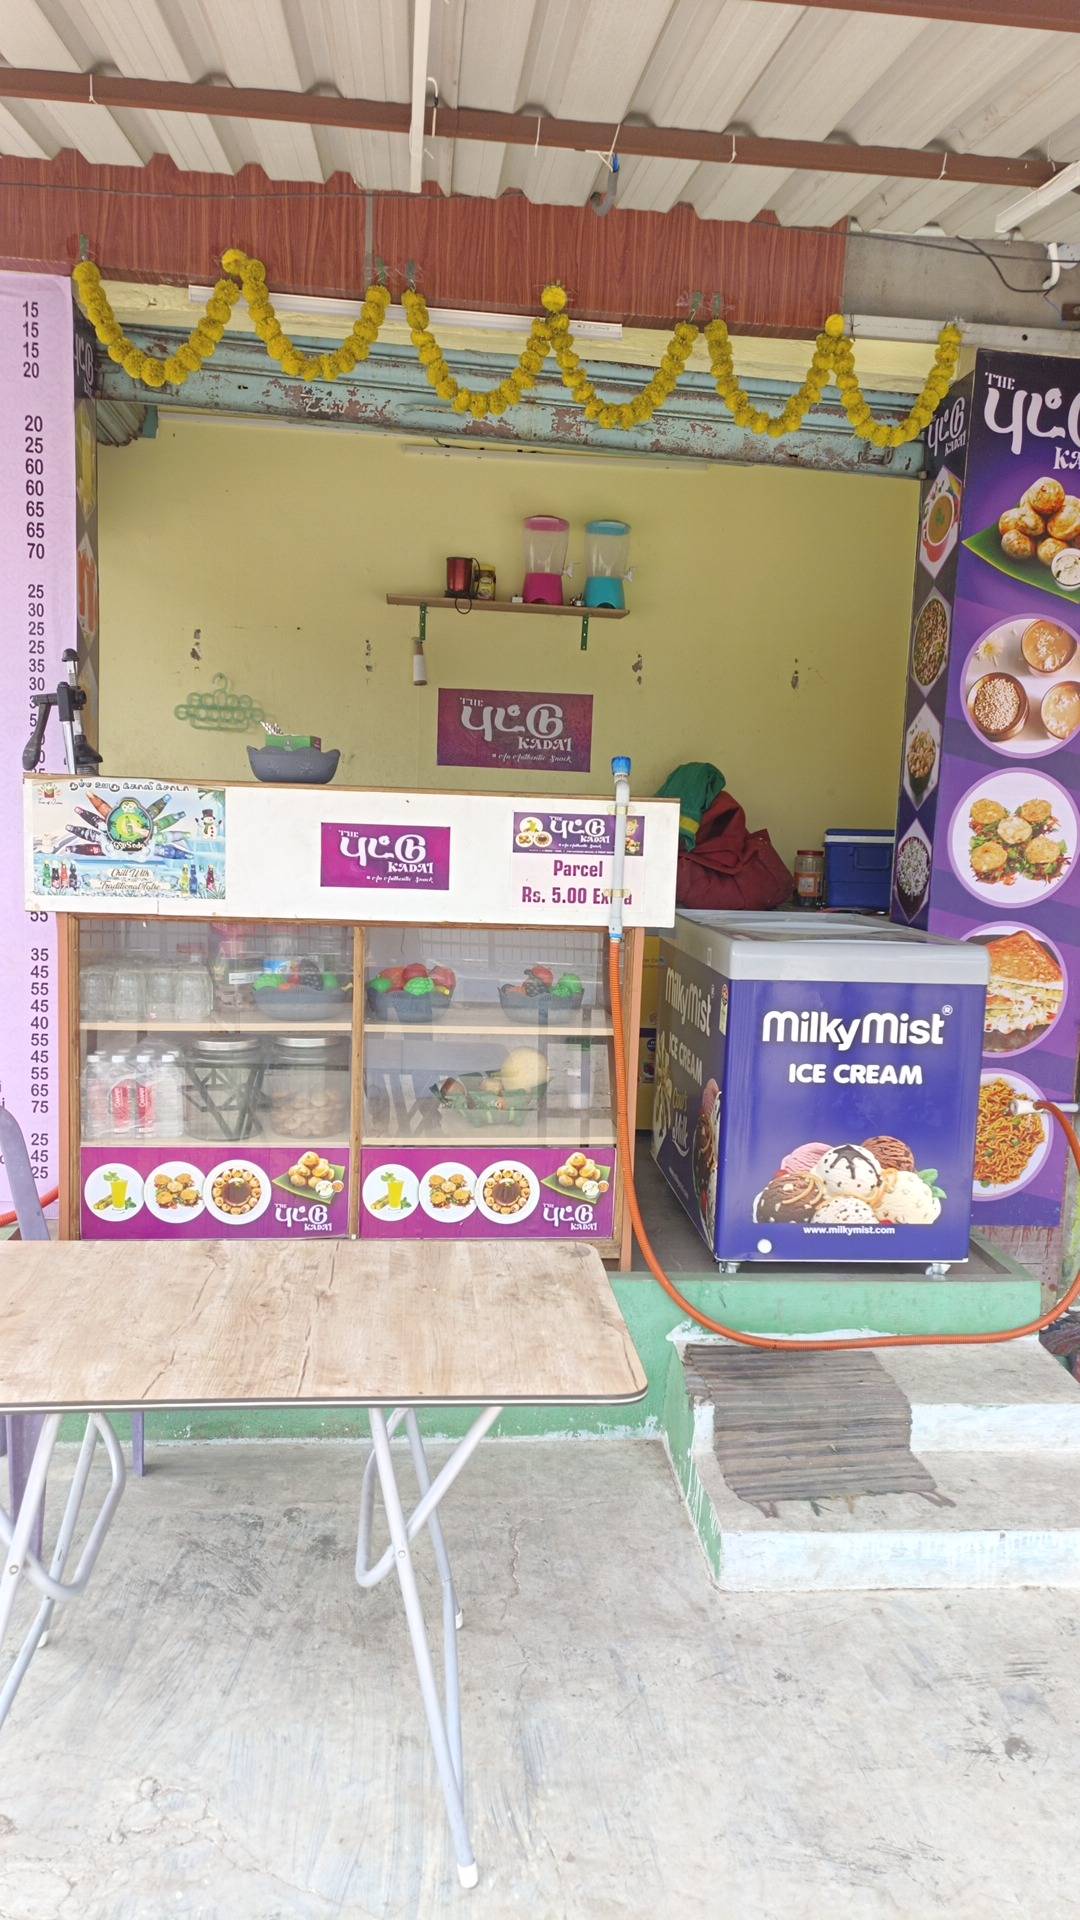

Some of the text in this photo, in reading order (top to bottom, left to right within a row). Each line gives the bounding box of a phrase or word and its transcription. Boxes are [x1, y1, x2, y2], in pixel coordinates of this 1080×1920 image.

[23, 300, 39, 318] 15
[23, 320, 39, 338] 15
[23, 341, 39, 359] 15
[23, 361, 40, 379] 20
[984, 371, 1016, 391] THE
[24, 414, 43, 432] 20
[25, 436, 44, 454] 25
[25, 458, 44, 475] 60
[26, 479, 44, 497] 60
[26, 501, 45, 518] 65
[27, 522, 45, 539] 65
[27, 542, 45, 560] 70
[28, 584, 44, 599] 25
[28, 603, 45, 618] 30
[28, 621, 45, 636] 25
[29, 640, 45, 655] 25
[29, 658, 45, 673] 35
[29, 676, 45, 691] 30
[459, 696, 484, 707] THE
[518, 737, 574, 752] KADAI
[340, 834, 427, 867] புட்டு
[388, 861, 434, 875] KADAI
[553, 859, 603, 878] Parcel
[521, 886, 546, 904] Rs.
[552, 887, 587, 904] 5.00
[31, 948, 49, 961] 35
[30, 965, 49, 978] 45
[31, 982, 49, 995] 55
[30, 999, 49, 1012] 45
[30, 1016, 49, 1029] 40
[31, 1033, 49, 1046] 55
[30, 1050, 49, 1063] 45
[31, 1067, 49, 1080] 55
[788, 1063, 923, 1085] ICE CREAM
[31, 1083, 49, 1097] 65
[31, 1100, 49, 1113] 75
[31, 1133, 49, 1146] 25
[30, 1149, 49, 1162] 45
[31, 1166, 49, 1179] 25
[803, 1225, 895, 1236] www.milkymist.com
